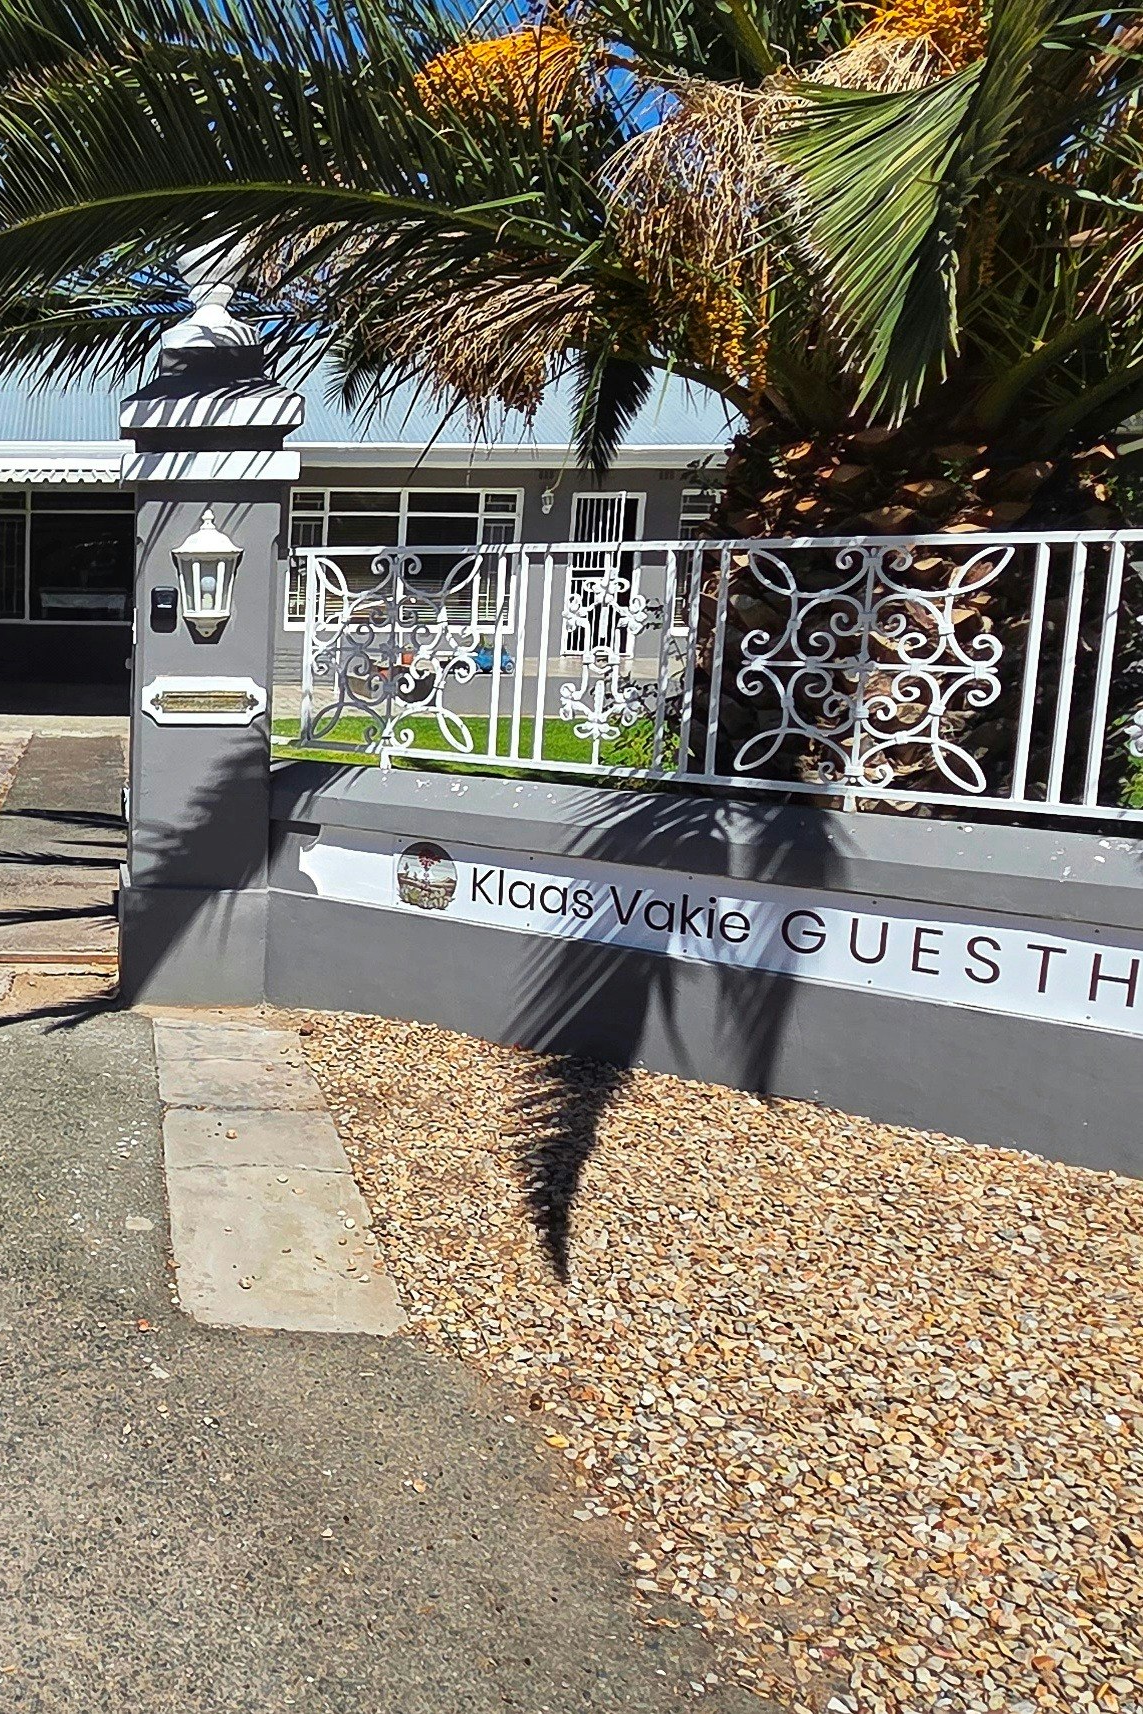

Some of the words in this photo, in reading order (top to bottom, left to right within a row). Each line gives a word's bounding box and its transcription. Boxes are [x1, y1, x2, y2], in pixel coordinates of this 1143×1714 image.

[470, 866, 595, 921] Klaas
[609, 885, 751, 944] Vakie
[780, 908, 1140, 1008] GUESTH
